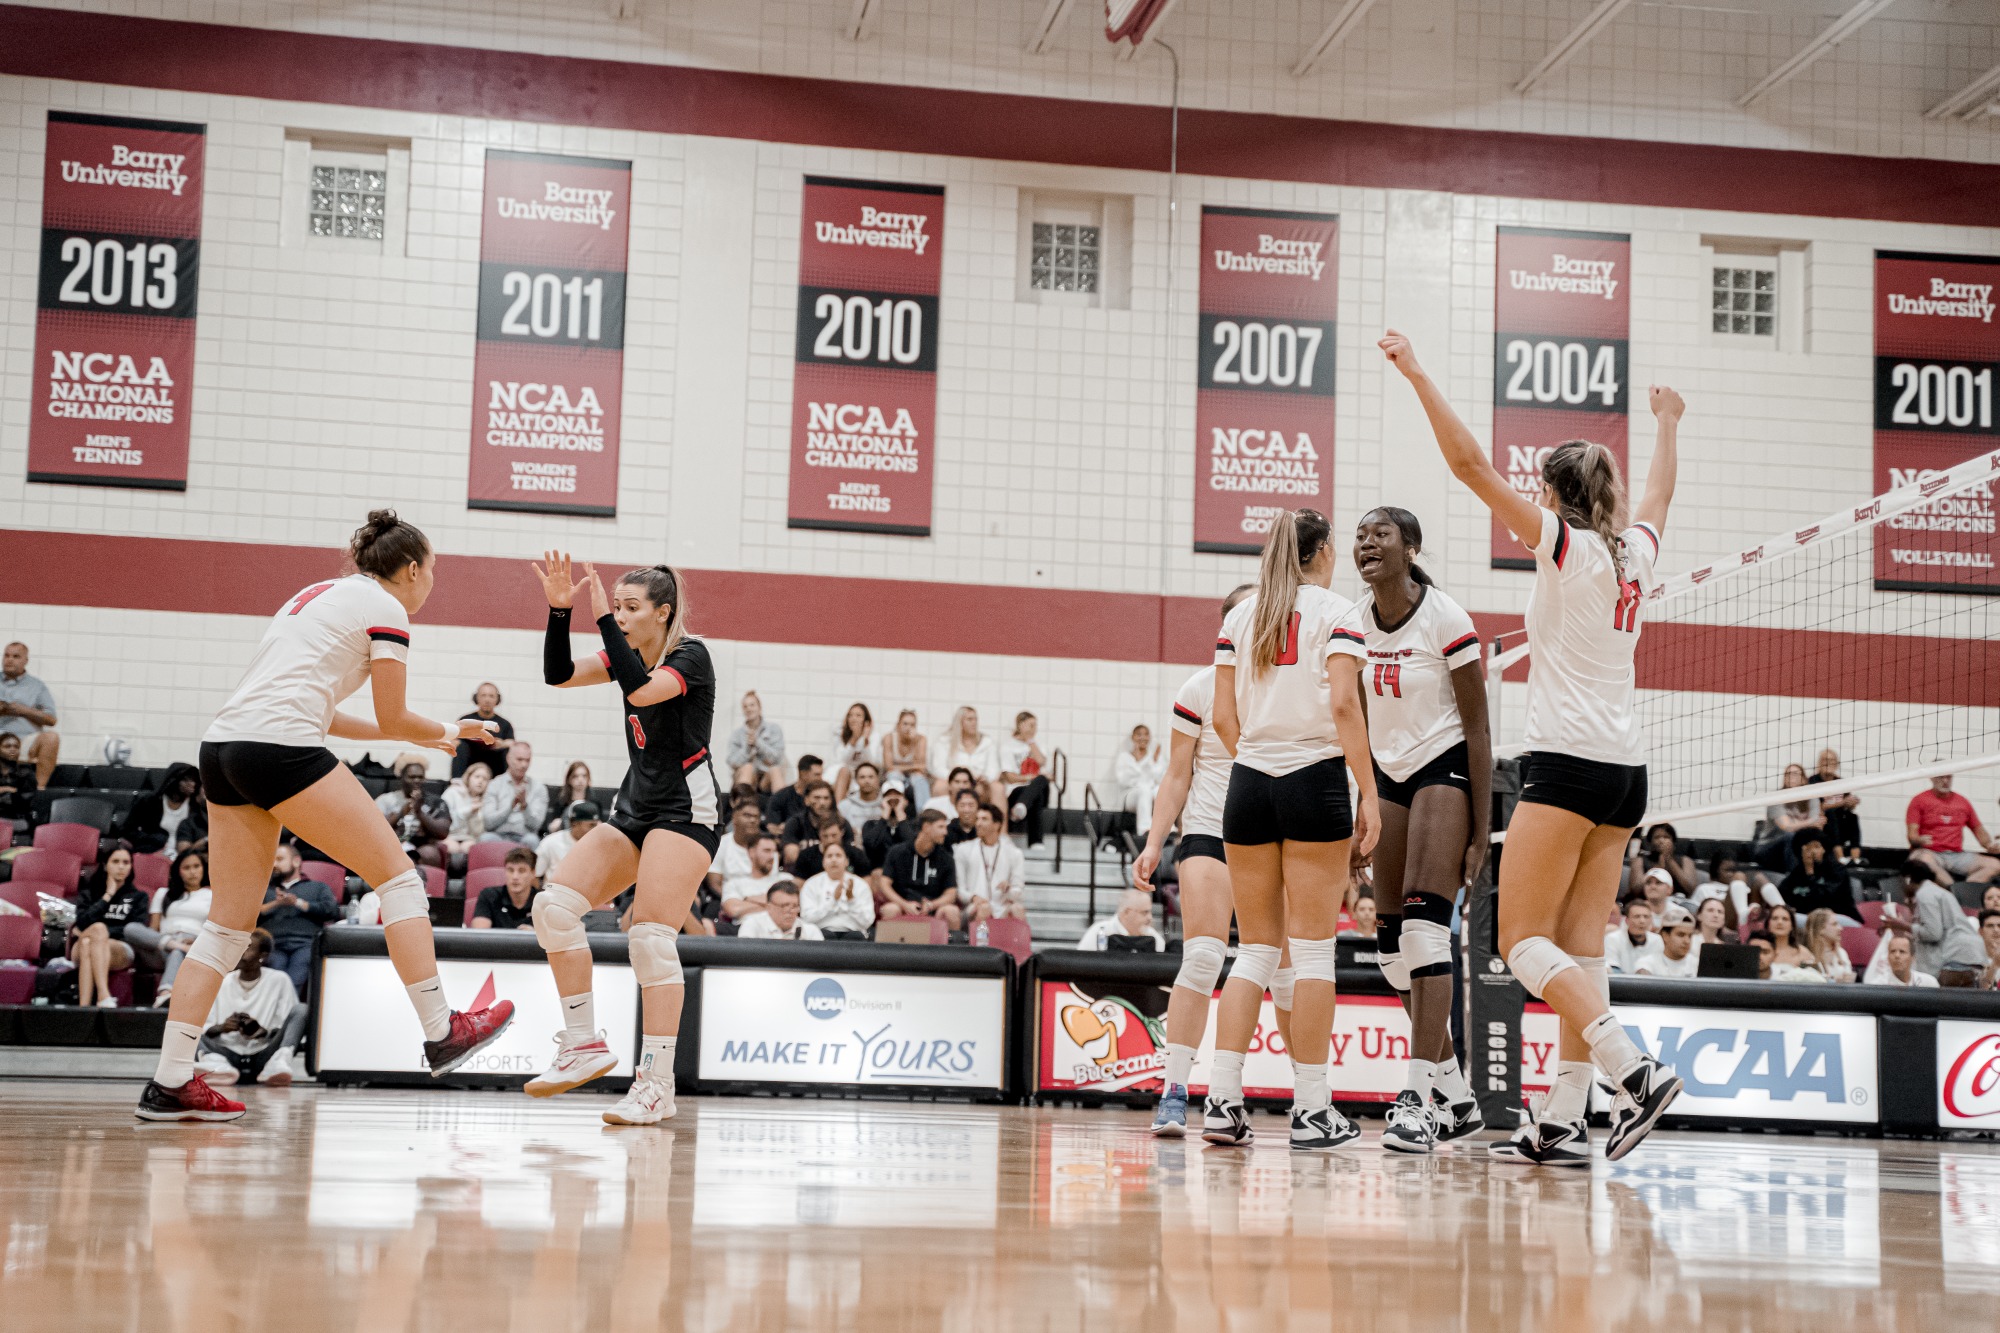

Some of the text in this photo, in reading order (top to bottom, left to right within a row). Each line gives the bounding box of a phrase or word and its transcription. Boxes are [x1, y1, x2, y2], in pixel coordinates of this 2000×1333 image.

[112, 145, 186, 173] Barry
[60, 160, 188, 195] University
[545, 181, 613, 209] Barry
[497, 197, 616, 230] University
[861, 206, 928, 234] Barry
[815, 221, 930, 255] University
[1258, 234, 1322, 261] Barry
[59, 237, 178, 310] 2013
[1214, 250, 1325, 280] University
[1552, 254, 1615, 279] Barry
[1509, 270, 1618, 300] University
[1930, 277, 1993, 302] Barry
[500, 271, 604, 340] 2011
[1887, 294, 1996, 323] University
[813, 294, 922, 364] 2010
[51, 350, 174, 386] NCAA
[1212, 321, 1323, 387] 2007
[1506, 339, 1619, 405] 2004
[50, 382, 173, 406] NATIONAL
[488, 381, 604, 415] NCAA
[1892, 363, 1992, 428] 2001
[48, 401, 174, 424] CHAMPIONS
[488, 411, 604, 435] NATIONAL
[807, 402, 918, 437] NCAA
[86, 434, 131, 448] MEN'S
[486, 430, 604, 452] CHAMPIONS
[807, 432, 918, 456] NATIONAL
[1211, 427, 1319, 460] NCAA
[72, 447, 143, 465] TENNIS
[511, 461, 577, 477] WOMEN'S
[805, 450, 918, 473] CHAMPIONS
[1211, 457, 1319, 479] NATIONAL
[1507, 445, 1556, 473] NC
[511, 475, 576, 492] TENNIS
[839, 482, 880, 496] MEN'S
[1210, 475, 1320, 496] CHAMPIONS
[827, 494, 891, 512] TENNIS
[1240, 518, 1274, 533] GO
[1888, 514, 1996, 533] CHAMPIONS
[1890, 549, 1995, 568] VOLLEYBALL
[1373, 663, 1402, 698] 14
[628, 714, 646, 749] 8
[807, 997, 845, 1012] NCAA
[850, 999, 893, 1011] Division
[467, 1055, 533, 1071] SPORTS
[721, 1023, 977, 1081] MAKE IT YOURS
[1620, 1025, 1847, 1104] NCAA
[1074, 1053, 1166, 1085] Buccane
